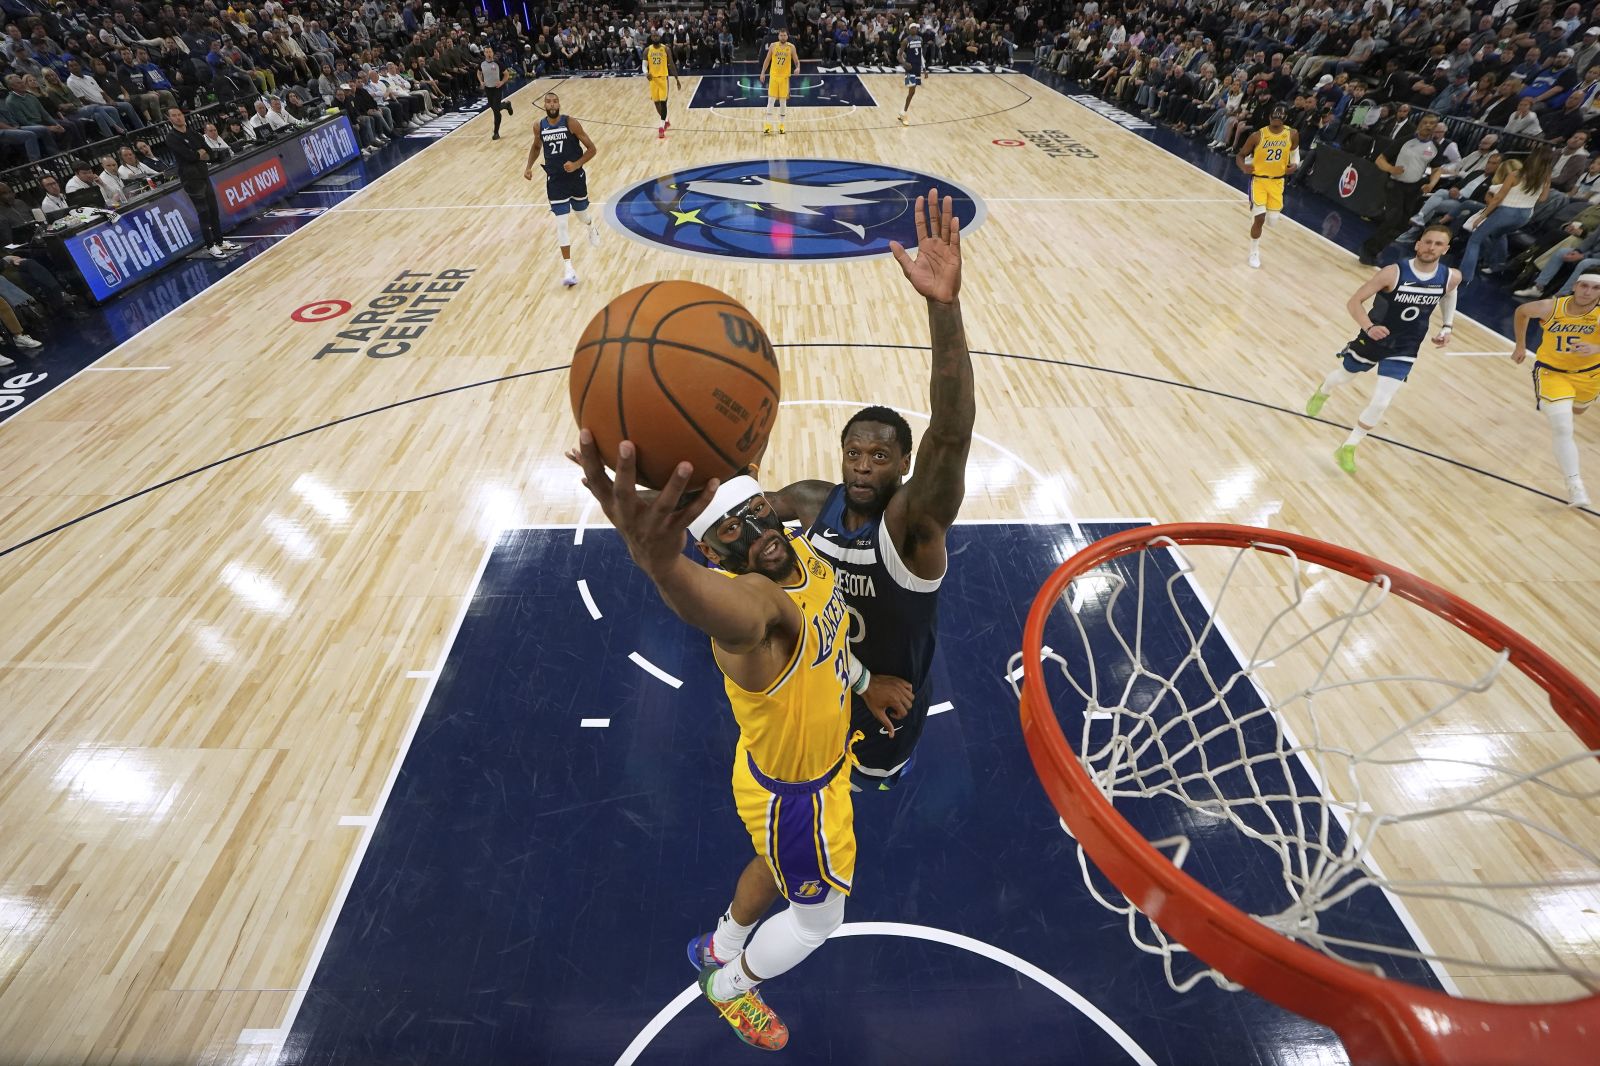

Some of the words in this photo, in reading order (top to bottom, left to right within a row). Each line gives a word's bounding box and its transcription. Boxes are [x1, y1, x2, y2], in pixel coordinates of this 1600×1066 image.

[816, 65, 1020, 74] MINNSOTA
[542, 132, 568, 142] MINNESOTA
[1016, 129, 1071, 159] TARGET
[1041, 129, 1100, 159] CENTER
[1263, 140, 1287, 149] LAKERS
[548, 140, 564, 155] 27
[1266, 148, 1283, 161] 28
[224, 178, 257, 207] PLAY
[254, 165, 280, 192] NOW
[100, 205, 194, 279] Pick'Em
[1393, 292, 1441, 305] MINNESOTA
[311, 269, 432, 360] TARGET
[366, 268, 476, 359] CENTER
[1400, 305, 1420, 322] 0
[1547, 320, 1596, 335] LAKERS
[811, 585, 849, 669] LAKER
